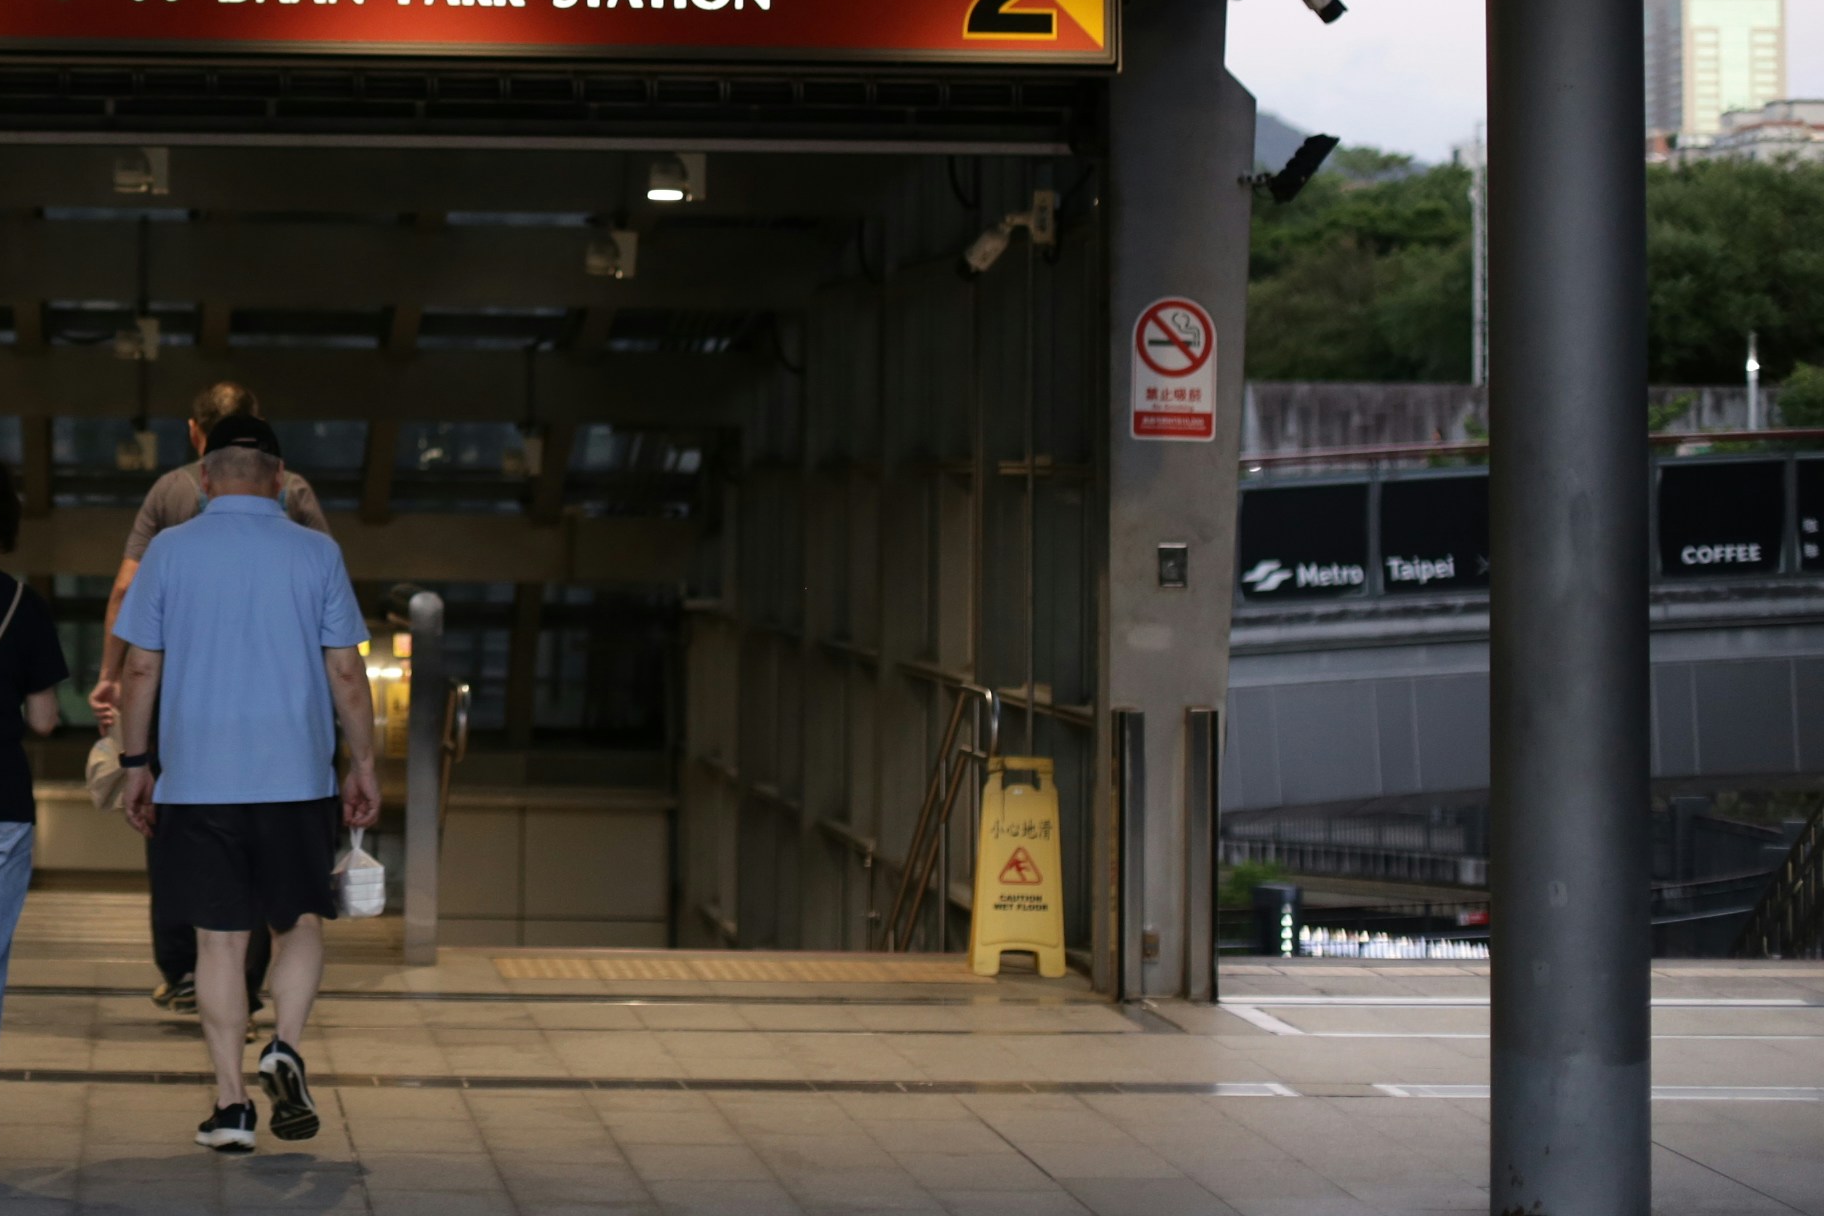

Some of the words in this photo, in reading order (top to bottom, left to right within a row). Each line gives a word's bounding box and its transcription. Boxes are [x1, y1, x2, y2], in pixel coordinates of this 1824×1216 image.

[1680, 542, 1763, 565] COFFEE
[1295, 560, 1365, 588] Metro
[1385, 553, 1456, 585] Taipei
[991, 819, 1053, 840] 小心地滑
[993, 902, 1014, 912] WET
[1016, 902, 1049, 912] FLOOR
[998, 894, 1043, 903] CAUTION
